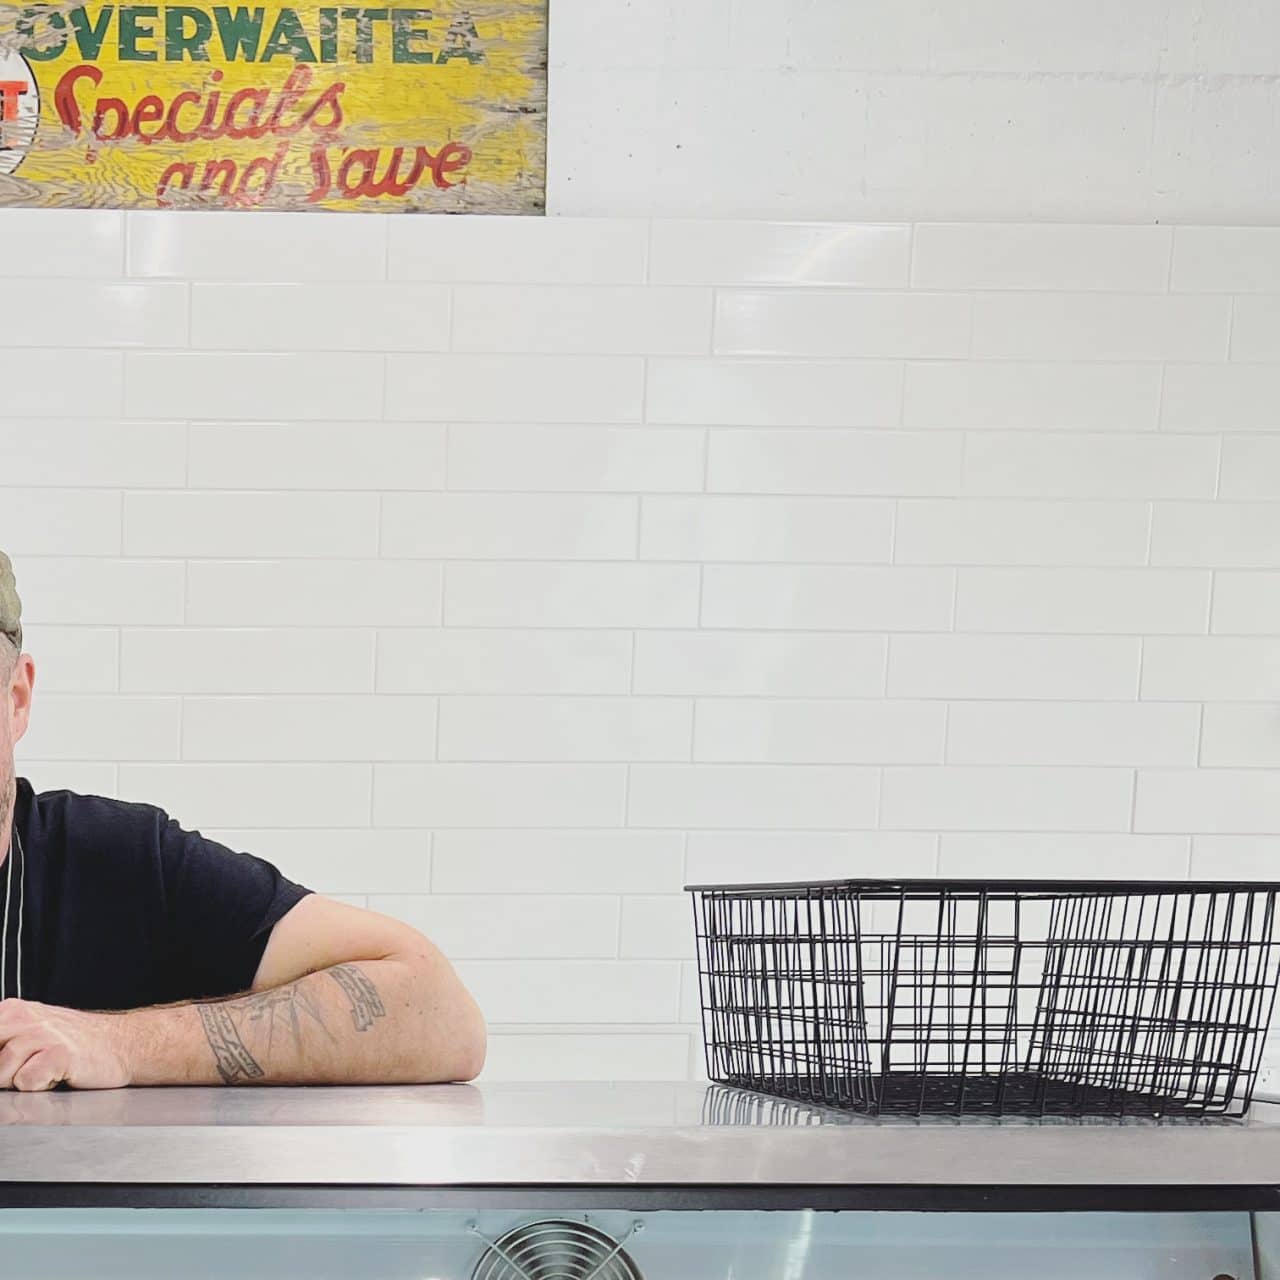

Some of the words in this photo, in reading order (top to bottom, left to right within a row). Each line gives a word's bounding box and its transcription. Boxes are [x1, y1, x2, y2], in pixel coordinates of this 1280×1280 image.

[16, 4, 485, 65] OVERWAITEA
[54, 64, 345, 152] Specials
[156, 141, 290, 206] and
[308, 136, 472, 204] Save
